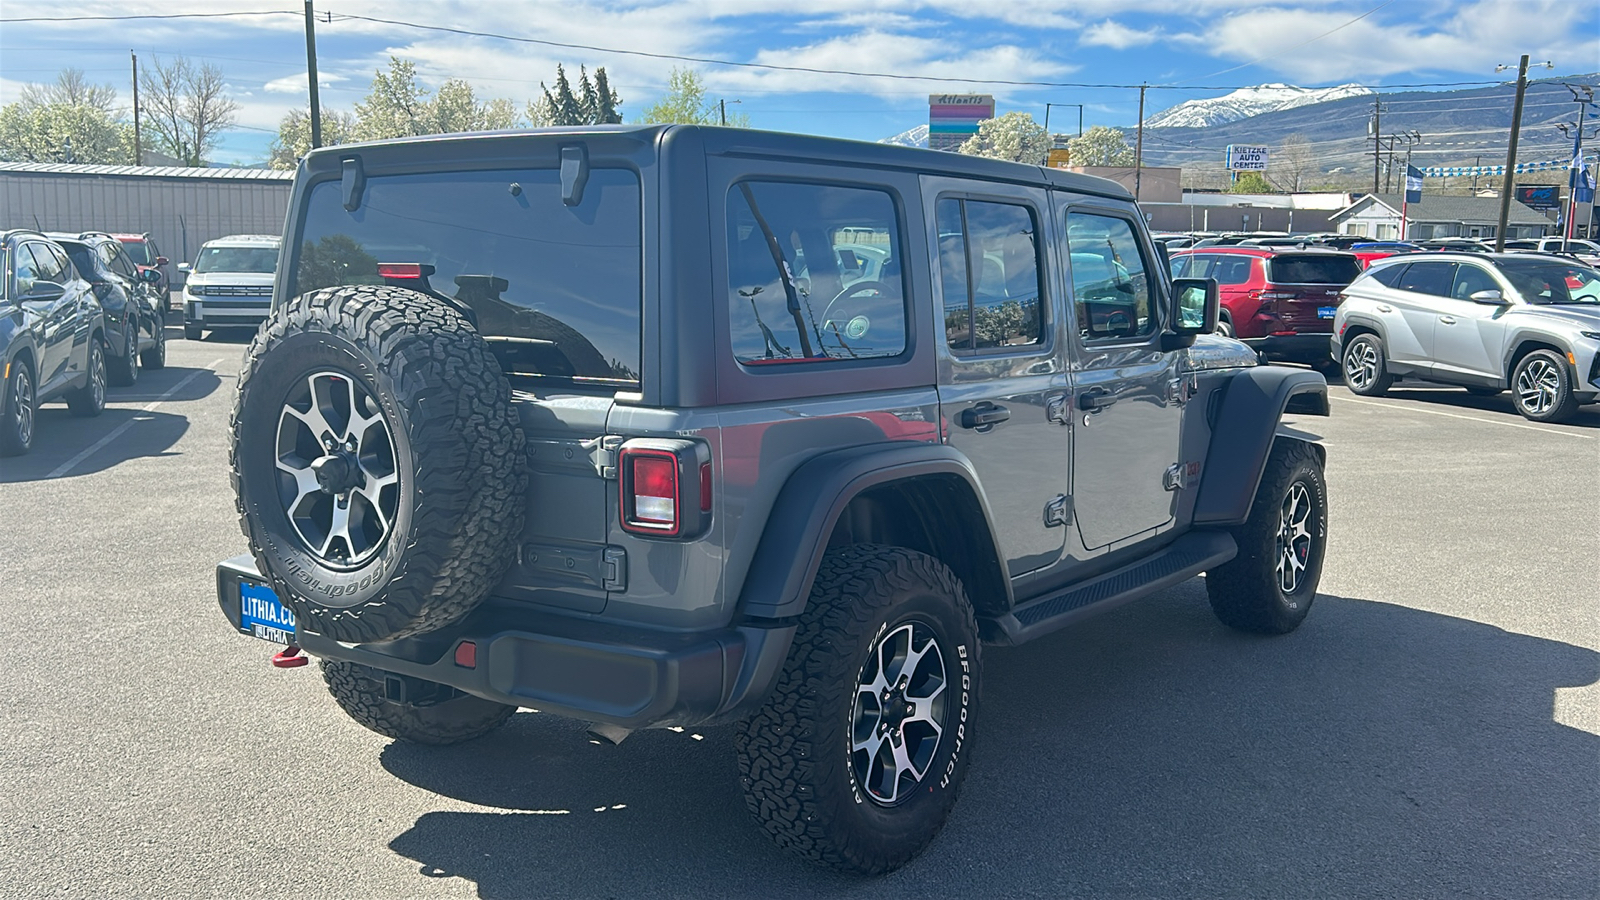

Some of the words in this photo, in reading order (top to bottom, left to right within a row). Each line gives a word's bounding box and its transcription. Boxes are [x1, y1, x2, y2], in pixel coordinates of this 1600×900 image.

[938, 94, 983, 104] Atlantis
[1233, 161, 1265, 169] CENTER
[262, 625, 288, 645] LITHIA
[940, 644, 971, 790] BFGoodrich
